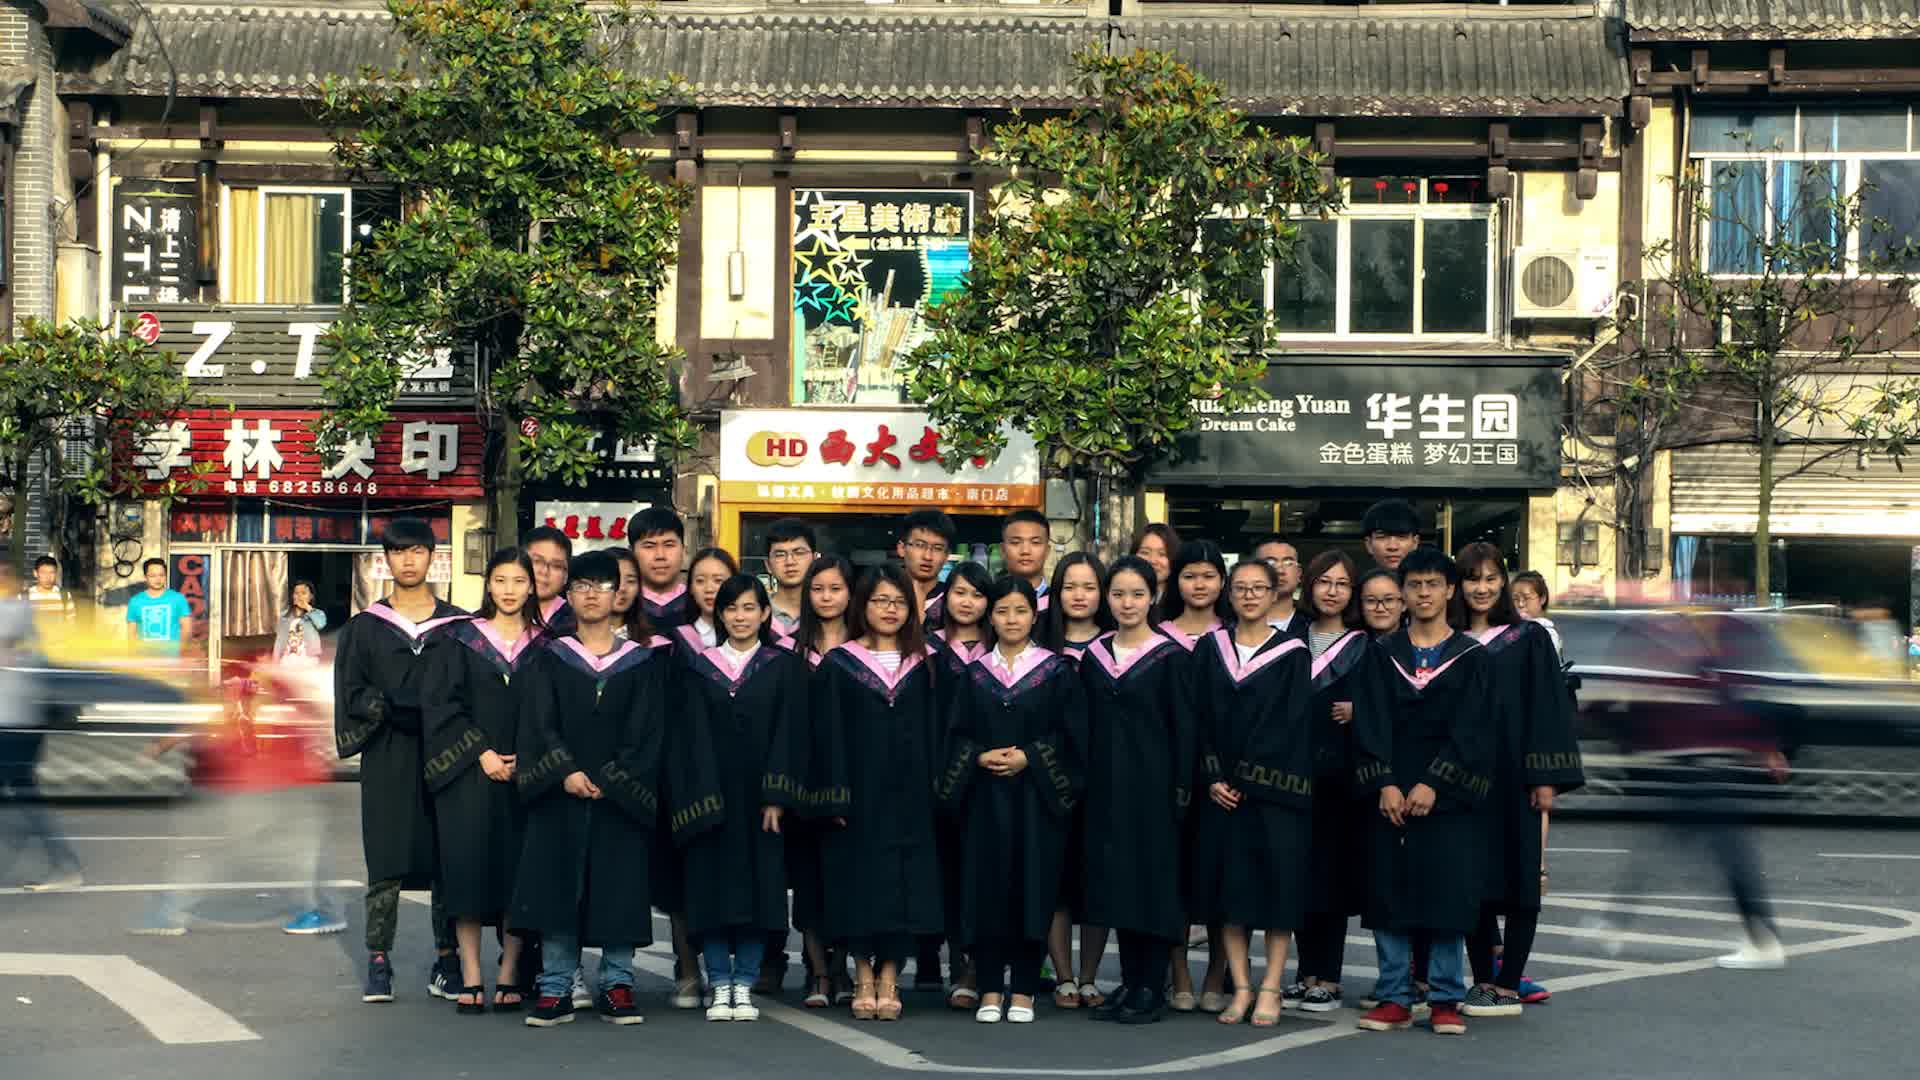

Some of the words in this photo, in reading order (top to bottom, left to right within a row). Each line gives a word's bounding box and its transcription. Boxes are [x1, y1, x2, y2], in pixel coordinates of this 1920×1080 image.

[1295, 394, 1352, 414] Yuan
[1200, 417, 1254, 432] Dream
[1255, 417, 1297, 432] Cake
[1366, 392, 1520, 440] 华生园
[766, 437, 808, 457] HD
[819, 423, 986, 470] 西大文
[1319, 442, 1415, 465] 金色蛋糕
[1423, 442, 1519, 466] 梦幻王国
[223, 481, 256, 494] 电话
[268, 480, 378, 496] 68258648
